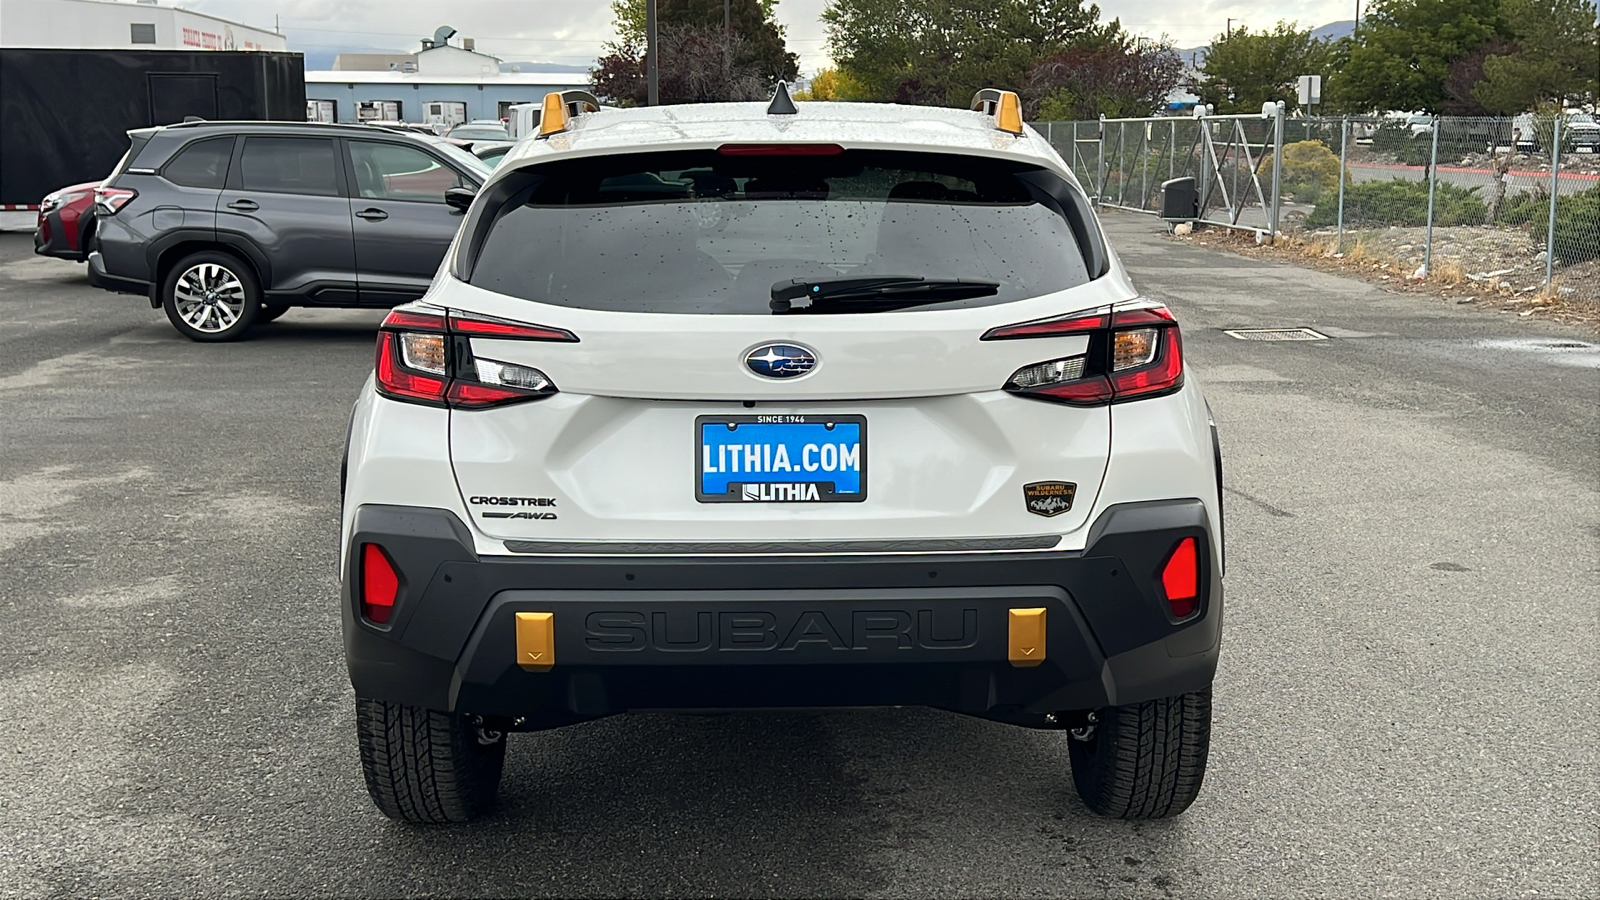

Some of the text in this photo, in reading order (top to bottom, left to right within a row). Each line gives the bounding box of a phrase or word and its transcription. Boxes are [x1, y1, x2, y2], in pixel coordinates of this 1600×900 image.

[702, 443, 860, 473] LITHIA.COM
[760, 483, 820, 501] LITHIA
[470, 496, 557, 507] CROSSTREK
[510, 512, 558, 520] AWD
[585, 608, 978, 652] SUBARU
